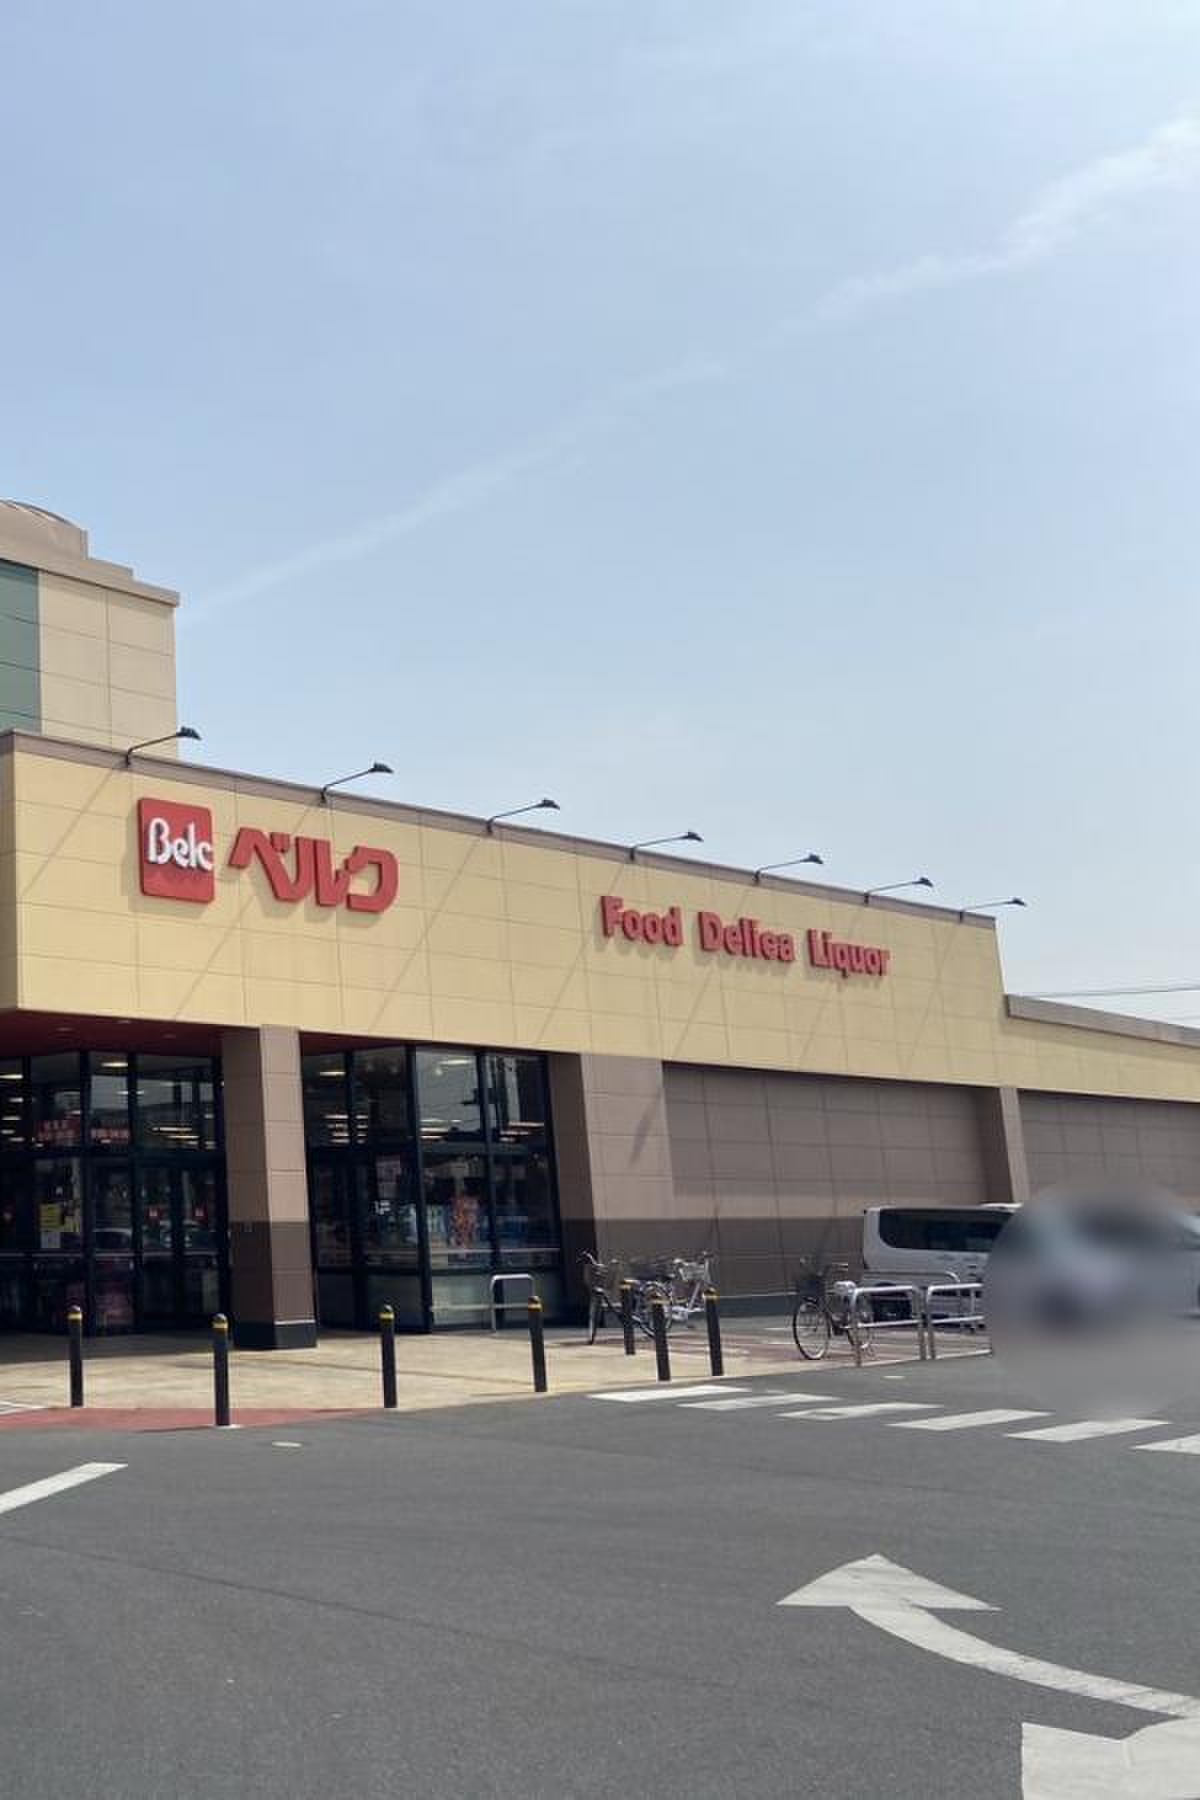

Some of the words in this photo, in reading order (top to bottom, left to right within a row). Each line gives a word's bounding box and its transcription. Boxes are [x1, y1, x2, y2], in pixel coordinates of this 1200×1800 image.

[147, 817, 213, 870] Belc
[227, 826, 399, 914] ベルク
[600, 895, 684, 946] Food
[698, 911, 795, 961] Delica
[807, 928, 890, 978] Liquor
